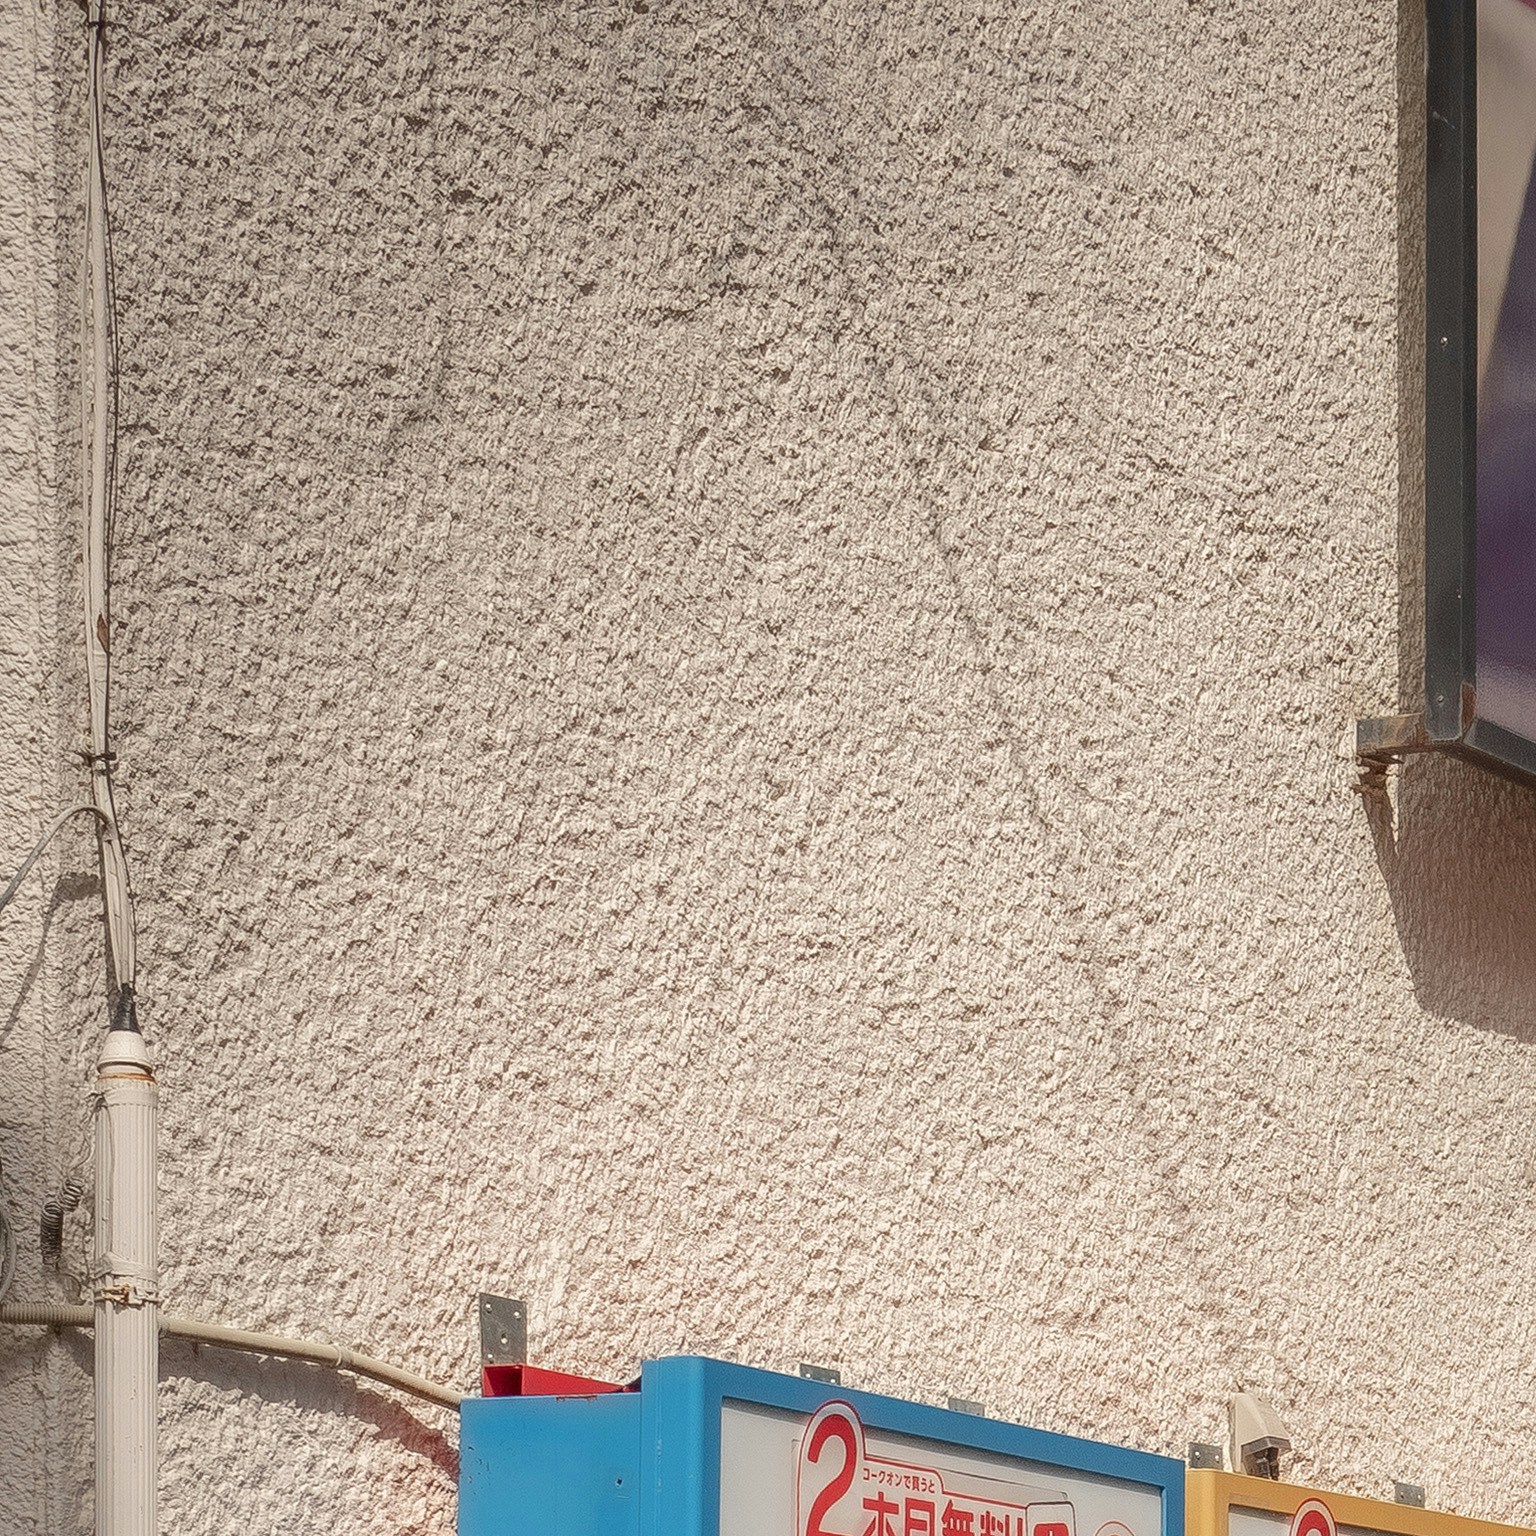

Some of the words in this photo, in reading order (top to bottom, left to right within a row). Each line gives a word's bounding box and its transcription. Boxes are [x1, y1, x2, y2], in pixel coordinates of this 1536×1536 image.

[862, 1467, 936, 1494] コークオンで買うと
